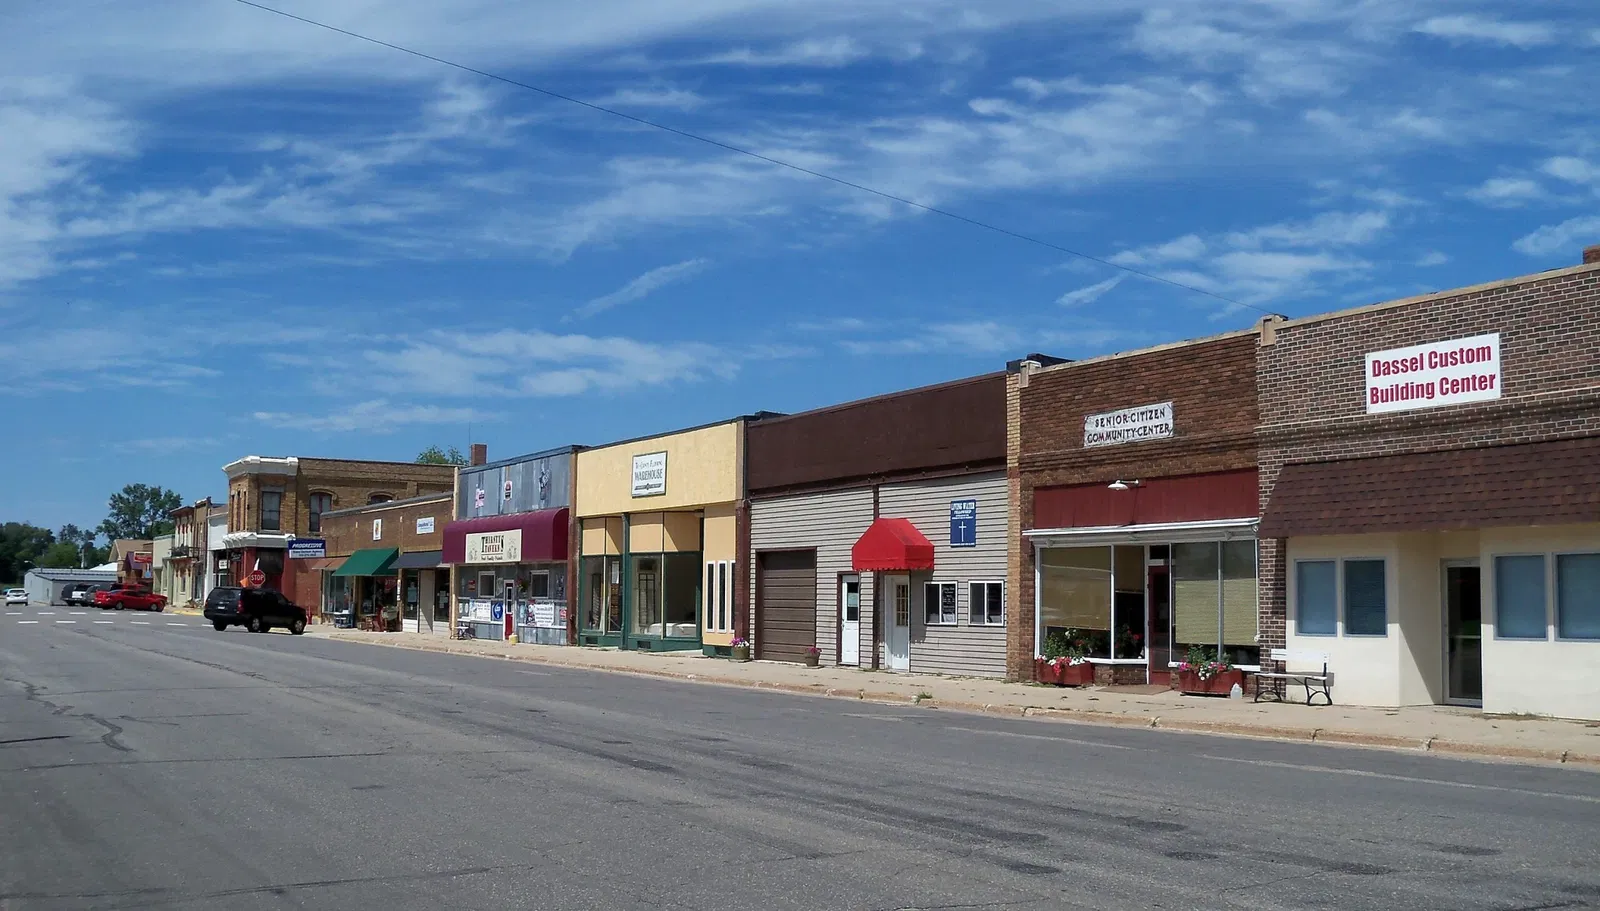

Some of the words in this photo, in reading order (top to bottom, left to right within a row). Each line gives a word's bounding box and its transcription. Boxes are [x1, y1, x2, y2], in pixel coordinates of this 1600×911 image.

[1372, 353, 1424, 377] Dassel
[1428, 345, 1492, 370] Custom
[1370, 381, 1435, 404] Building
[1439, 373, 1496, 396] Center
[634, 468, 663, 481] WAREHOUSE
